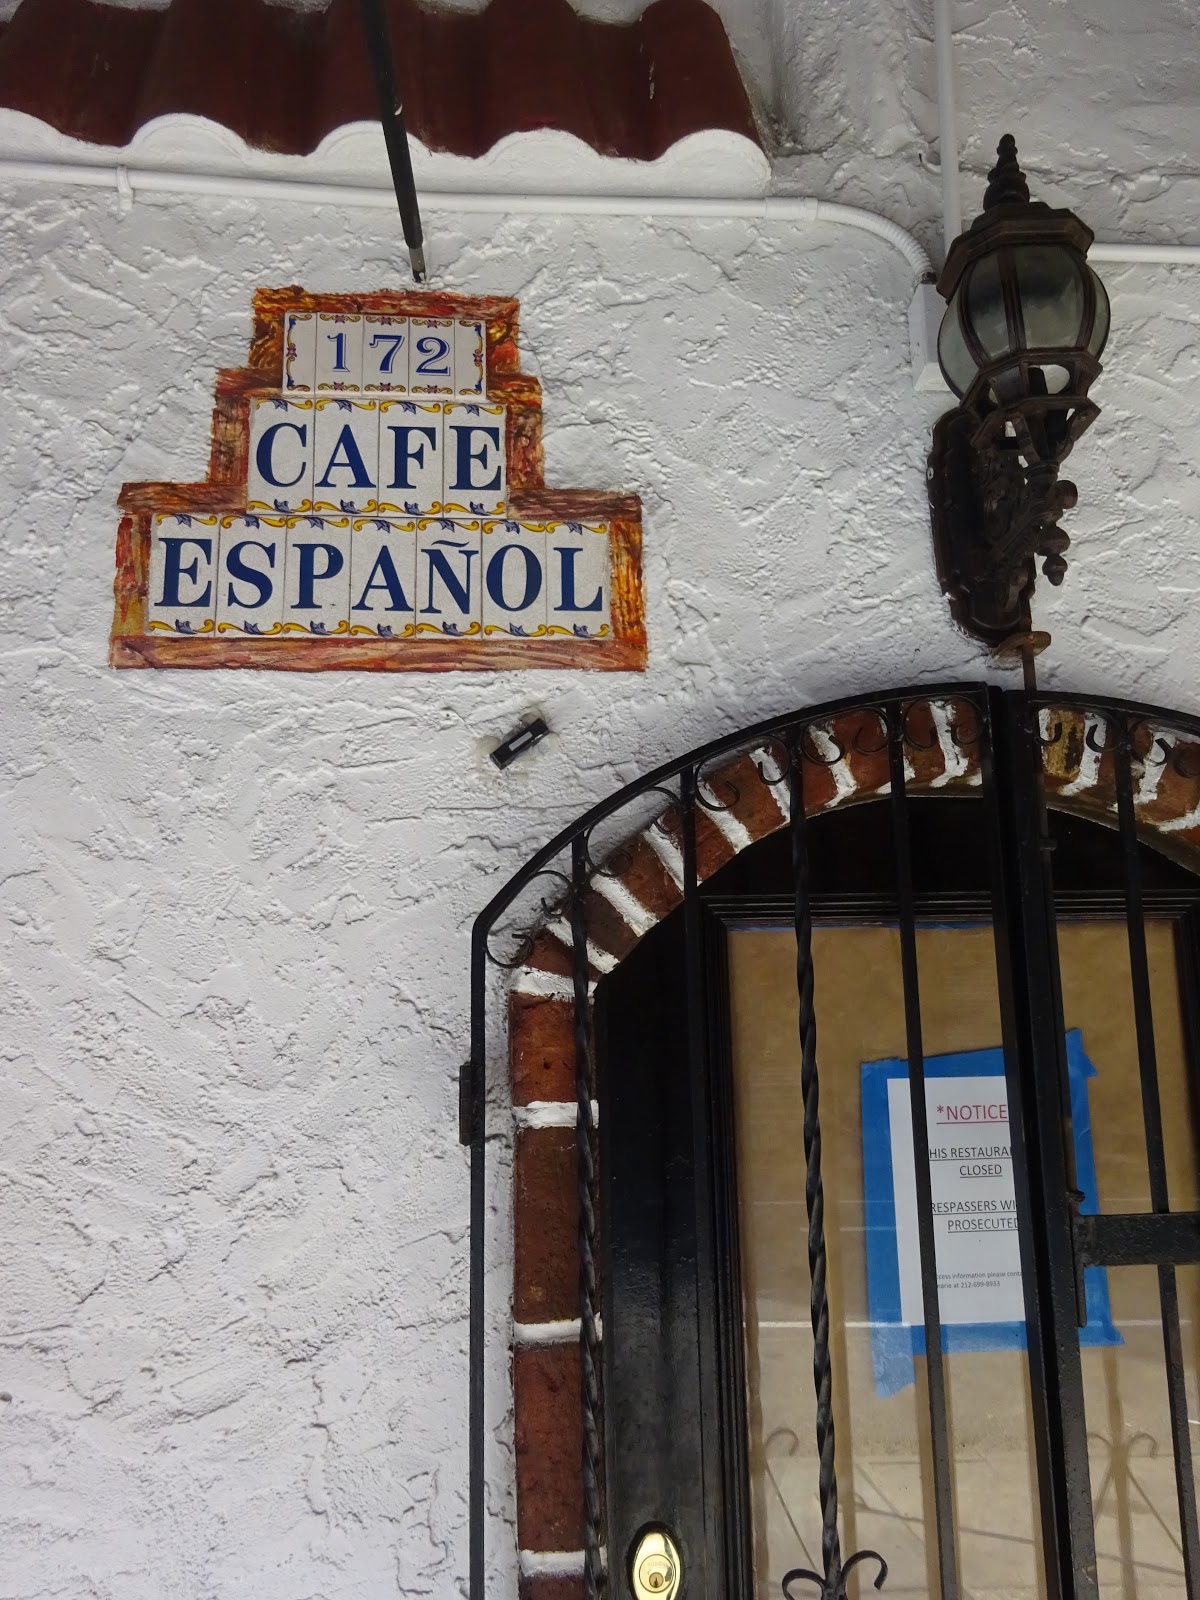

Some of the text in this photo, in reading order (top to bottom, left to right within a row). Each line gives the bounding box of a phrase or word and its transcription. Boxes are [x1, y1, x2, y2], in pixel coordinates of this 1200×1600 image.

[327, 332, 450, 376] 172
[255, 422, 501, 491] CAFE
[153, 537, 603, 615] ESPAÑOL
[929, 1146, 1012, 1159] HIS RESTAURA
[959, 1164, 1003, 1176] CLOSED
[931, 1199, 1016, 1213] RESPASSERS WI
[952, 1272, 987, 1280] information
[987, 1271, 1006, 1279] please
